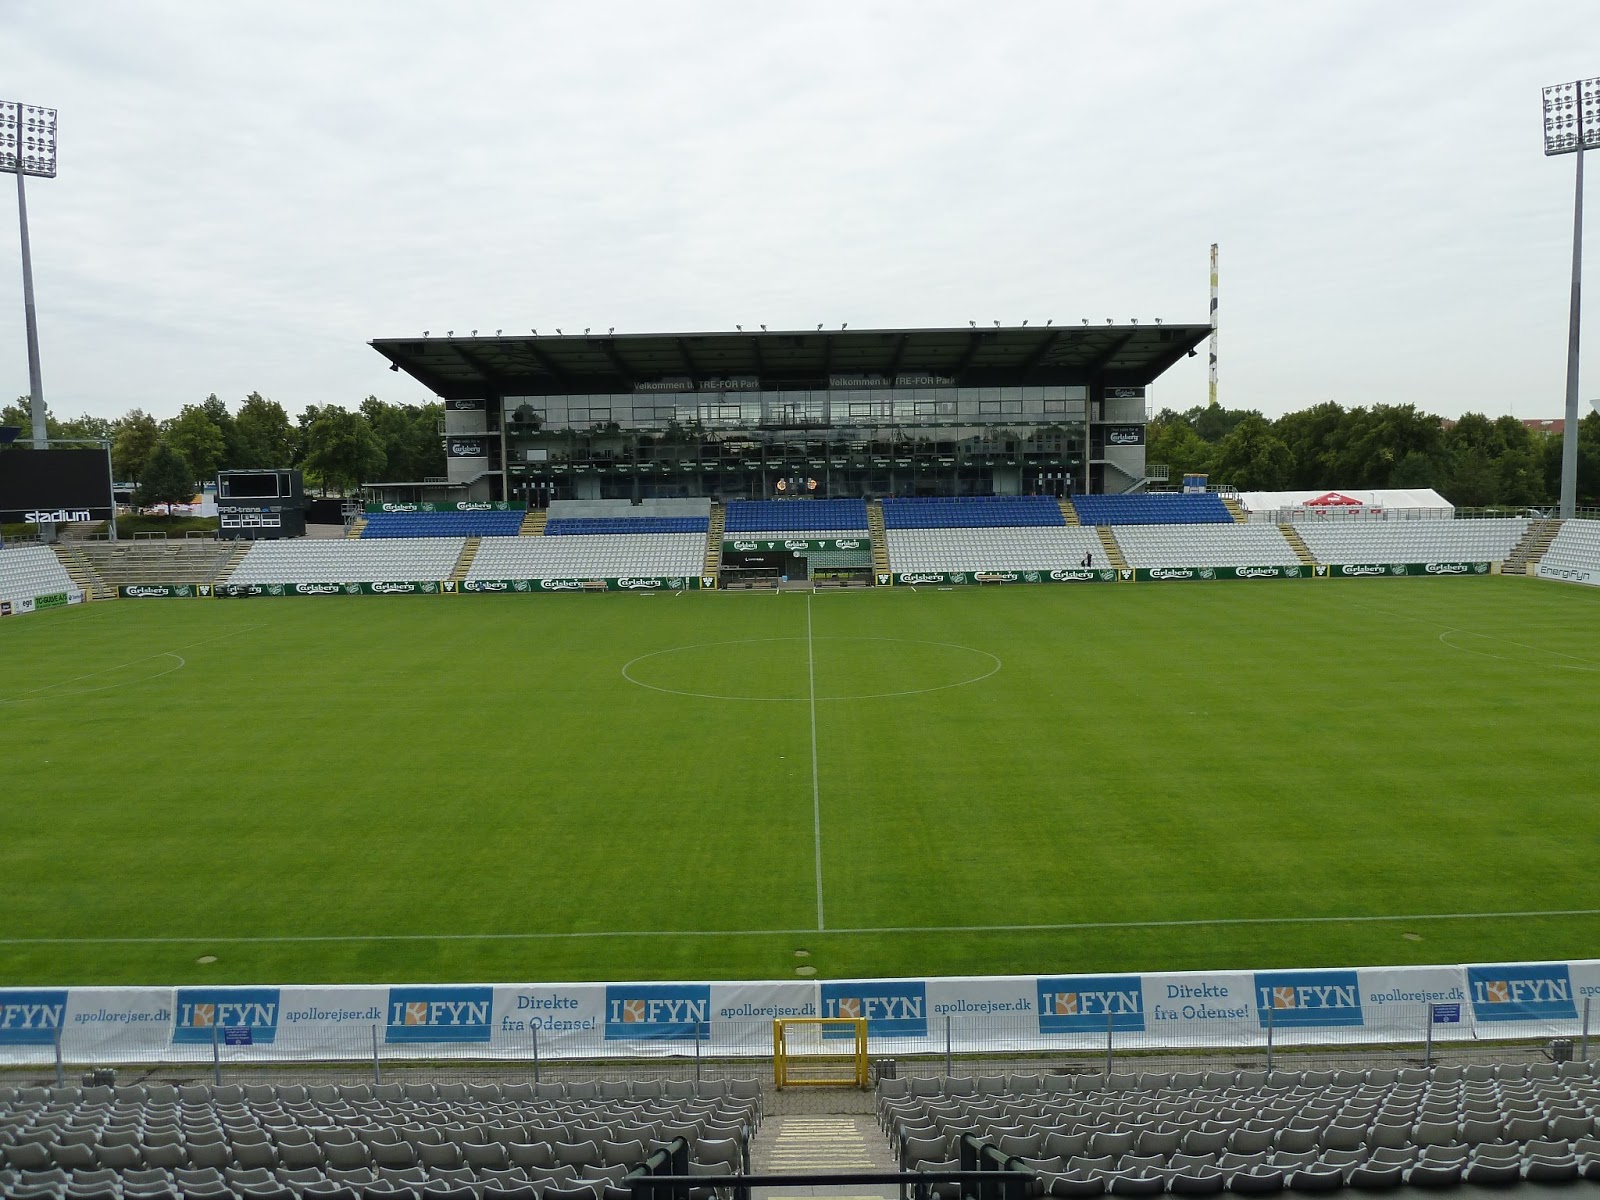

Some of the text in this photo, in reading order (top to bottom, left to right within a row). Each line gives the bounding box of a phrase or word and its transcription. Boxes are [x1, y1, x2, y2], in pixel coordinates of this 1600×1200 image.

[634, 381, 685, 390] Velkommen
[698, 380, 738, 388] TRE-FOR
[740, 379, 760, 388] Park
[829, 378, 880, 386] Velkommen
[936, 376, 956, 384] Park
[1110, 432, 1139, 444] Carlsberg
[453, 444, 481, 455] Carlsberg
[382, 503, 418, 512] Carlsberg
[456, 501, 492, 511] Carlsberg
[25, 509, 90, 523] stadium
[733, 541, 758, 551] Carlsberg
[784, 540, 809, 550] Carlsberg
[835, 539, 860, 549] Carlsberg
[1149, 567, 1193, 580] Carlsberg
[1235, 566, 1279, 578] Carlsberg
[1342, 564, 1385, 576] Carlsberg
[1425, 562, 1468, 574] Carlsberg
[899, 572, 944, 584] Carlsberg
[1050, 569, 1094, 581] Carlsberg
[296, 583, 339, 595] Carlsberg
[371, 582, 415, 594] Carlsberg
[617, 577, 660, 589] Carlsberg
[126, 585, 169, 597] Carlsberg
[1167, 983, 1228, 998] Direkte
[1296, 985, 1355, 1009] FYN
[1370, 988, 1465, 1004] apollorejser.dk
[1509, 979, 1568, 1003] FYN
[517, 994, 578, 1010] Direkte
[862, 996, 922, 1019] FYN
[934, 998, 1031, 1014] apollorejser.dk
[1079, 991, 1139, 1015] FYN
[1, 1004, 63, 1029] FYN
[75, 1009, 171, 1024] apollorejser.dk
[216, 1003, 275, 1026] FYN
[286, 1007, 382, 1022] apollorejser.dk
[429, 1001, 489, 1025] FYN
[647, 999, 707, 1023] FYN
[720, 1003, 816, 1018] apollorejser.dk
[1154, 1004, 1249, 1020] fra Odense!
[502, 1015, 596, 1031] fra Odense!
